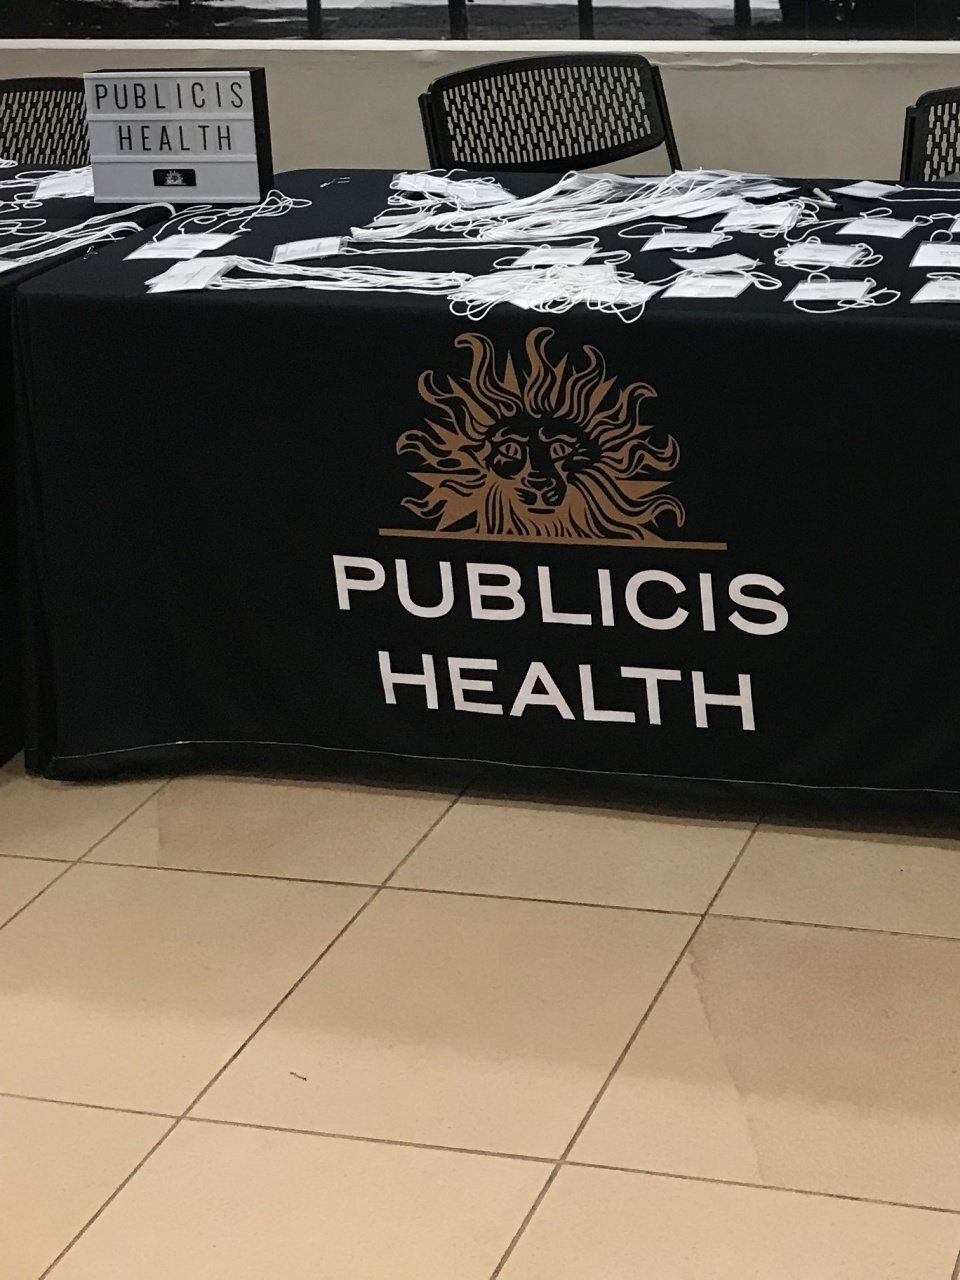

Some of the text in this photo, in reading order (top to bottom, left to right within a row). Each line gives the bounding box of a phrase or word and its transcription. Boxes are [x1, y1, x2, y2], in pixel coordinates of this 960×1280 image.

[95, 82, 243, 109] PUBLICIS
[118, 125, 232, 151] HEALTH
[332, 554, 789, 636] PUBLICIS
[378, 651, 756, 731] HEALTH
